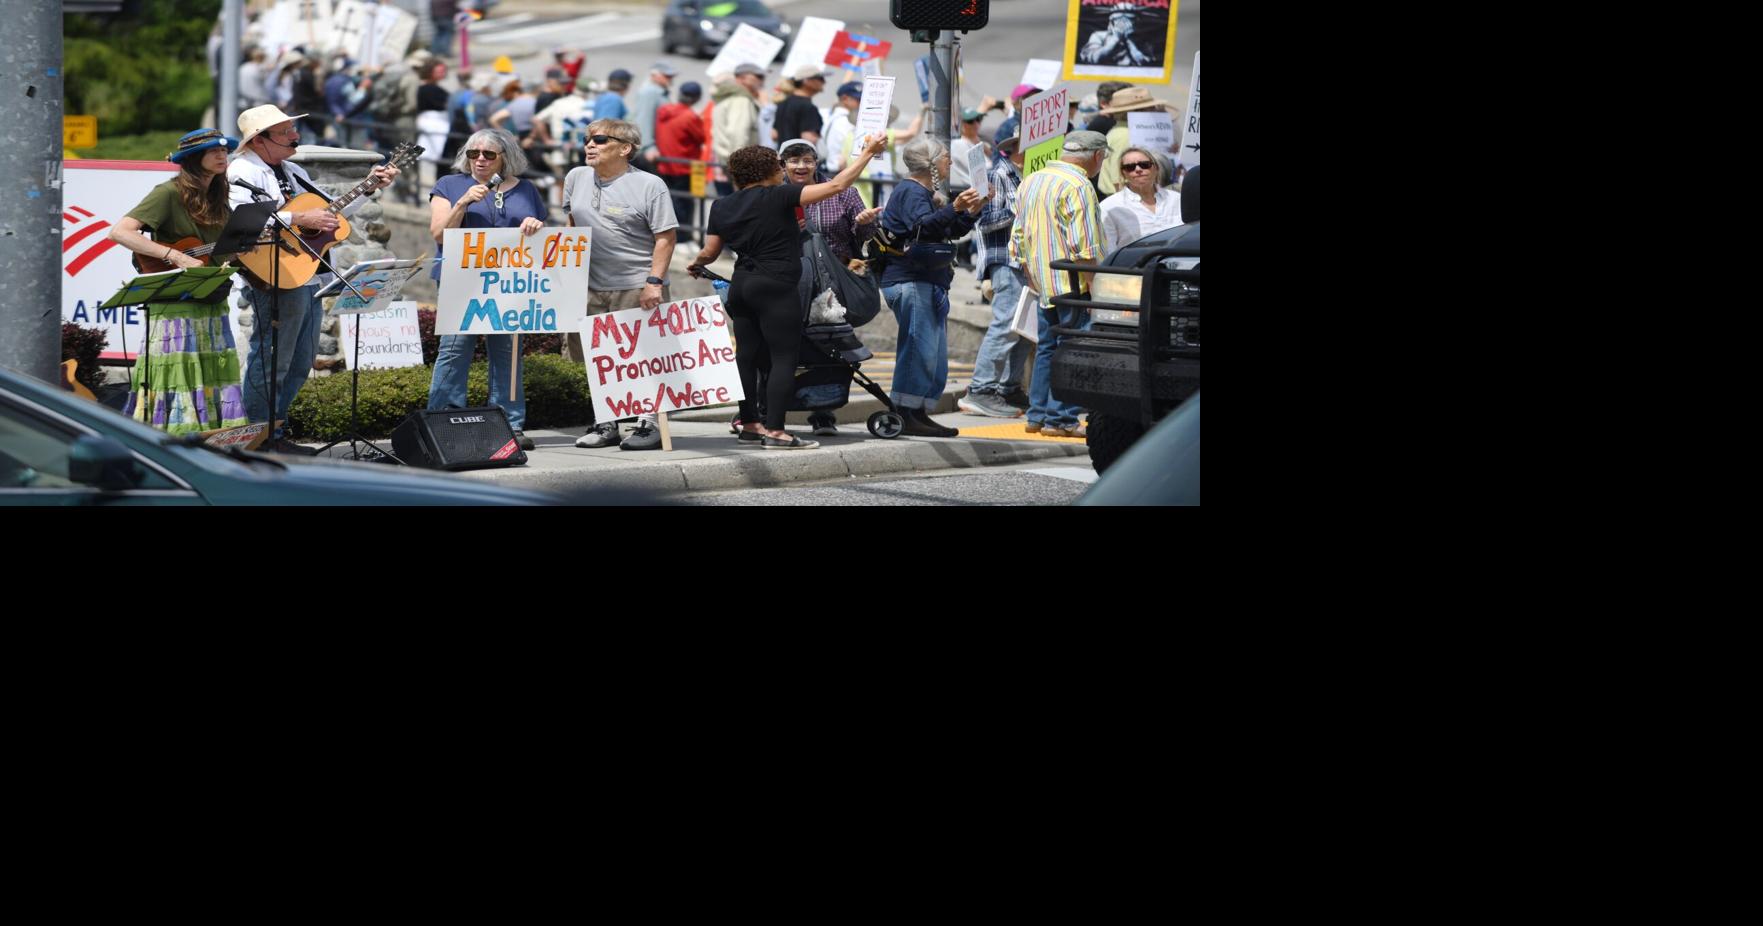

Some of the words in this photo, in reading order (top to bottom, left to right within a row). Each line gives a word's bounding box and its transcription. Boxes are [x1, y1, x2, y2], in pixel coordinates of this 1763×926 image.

[1025, 88, 1067, 125] DEPORT
[1028, 111, 1063, 141] KILEY
[461, 232, 534, 268] Hands
[480, 270, 551, 294] Public
[348, 324, 391, 338] Knows
[400, 325, 416, 336] no
[460, 298, 557, 331] Media
[357, 338, 422, 355] Boundaries
[591, 314, 641, 359] My
[592, 351, 696, 386] Pronouns
[698, 339, 735, 367] Are
[605, 382, 730, 417] Was/Were
[450, 415, 486, 424] CUBE
